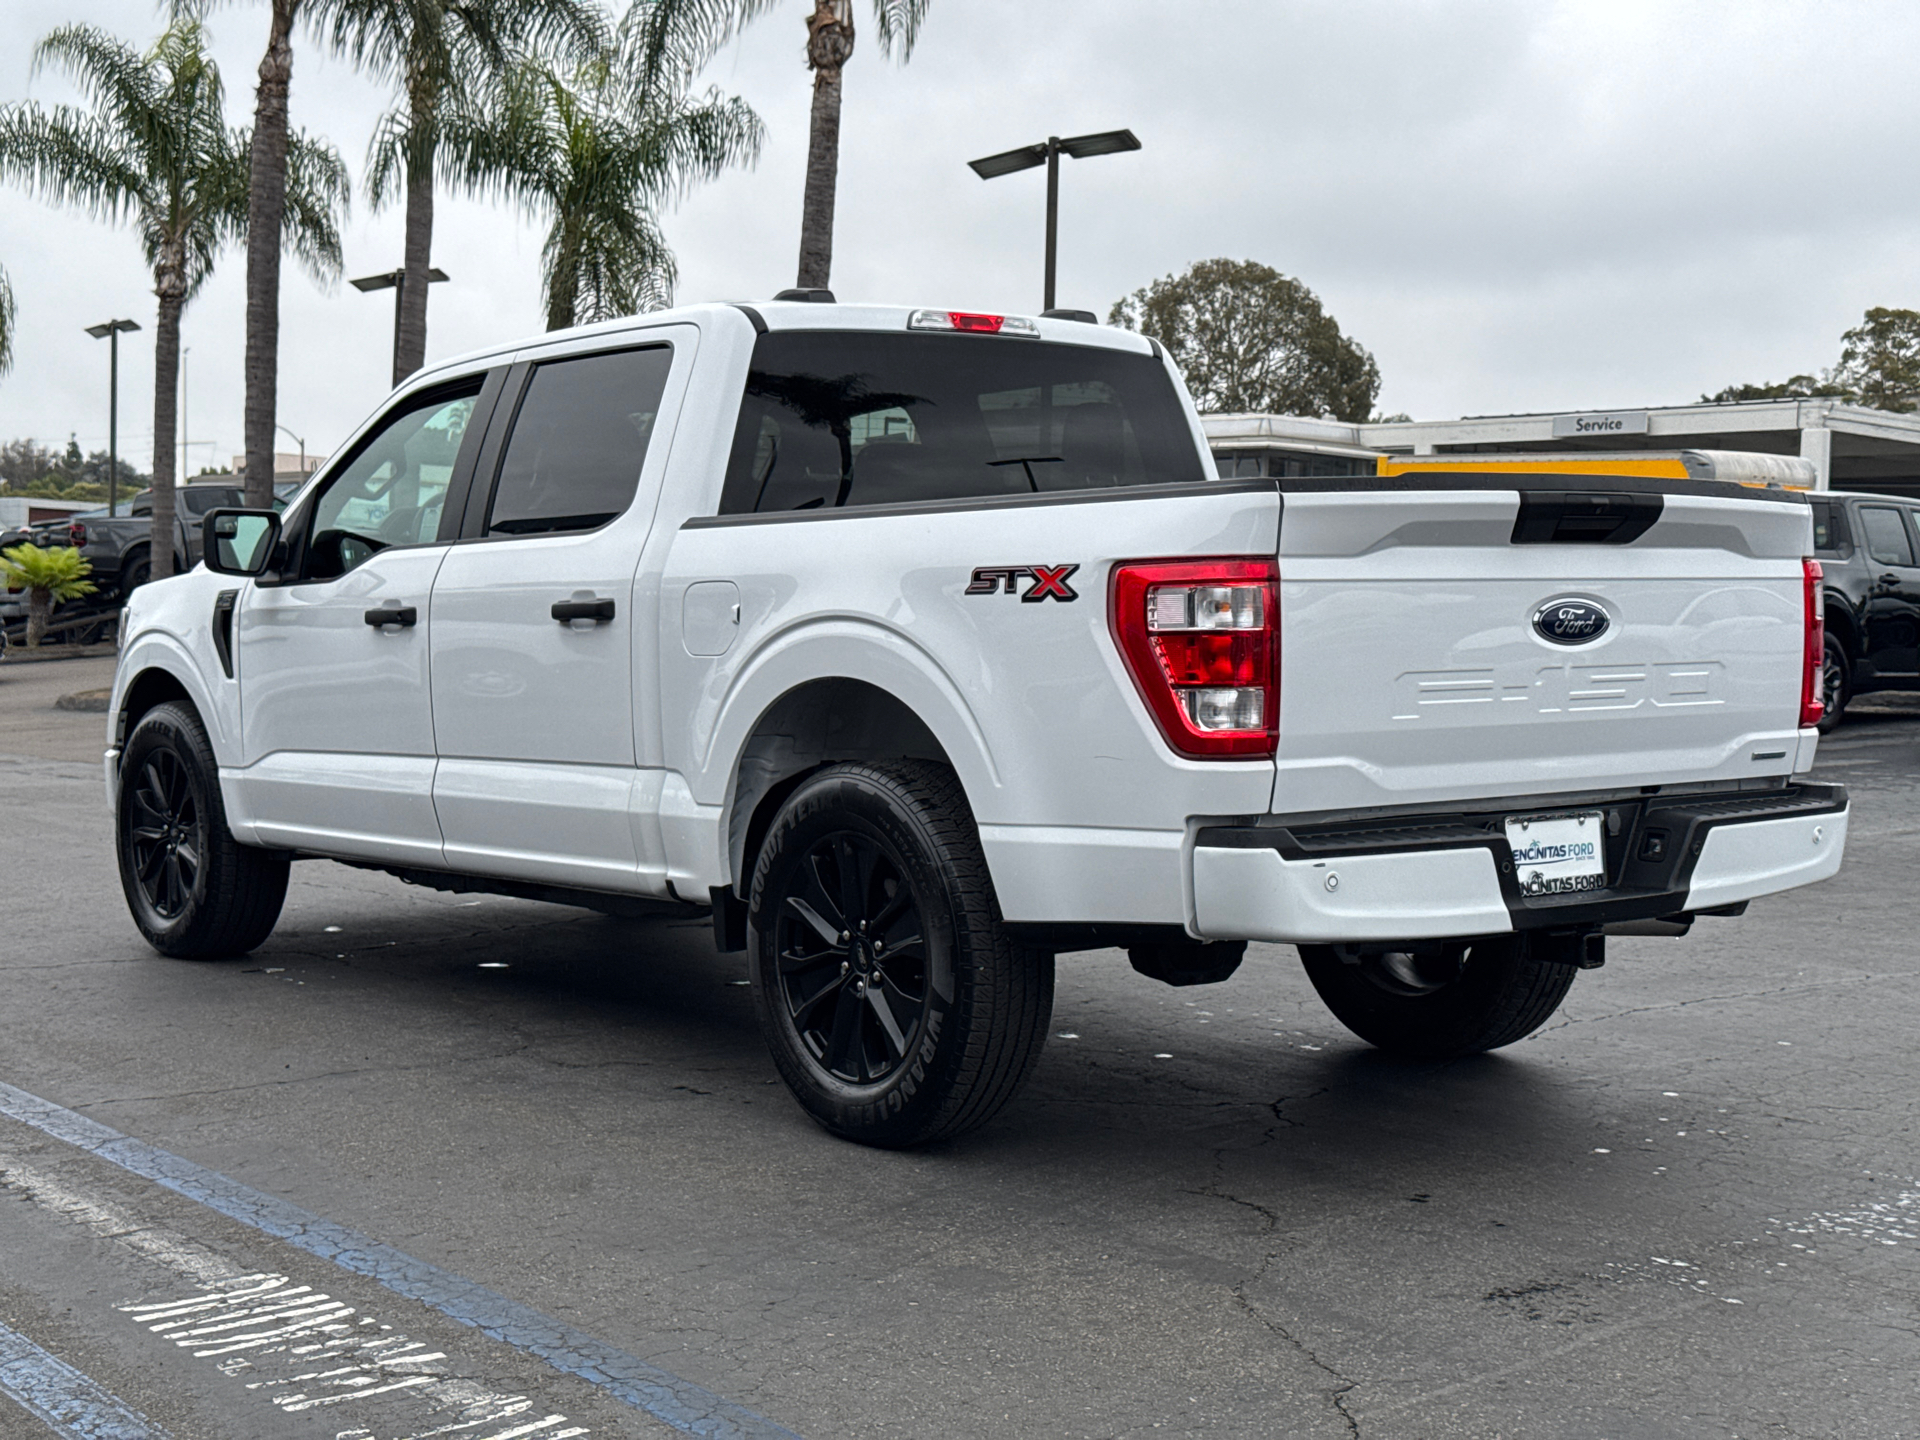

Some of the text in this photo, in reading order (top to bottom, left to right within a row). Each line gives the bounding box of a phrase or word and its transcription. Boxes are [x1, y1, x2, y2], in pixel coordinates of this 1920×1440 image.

[1575, 416, 1623, 432] Service
[964, 563, 1081, 604] STX
[1554, 607, 1596, 634] Ford
[1392, 660, 1726, 720] F-150
[1512, 844, 1567, 861] ENCINITAS
[1567, 841, 1594, 857] FORD
[1519, 875, 1604, 897] NCINITAS FORD
